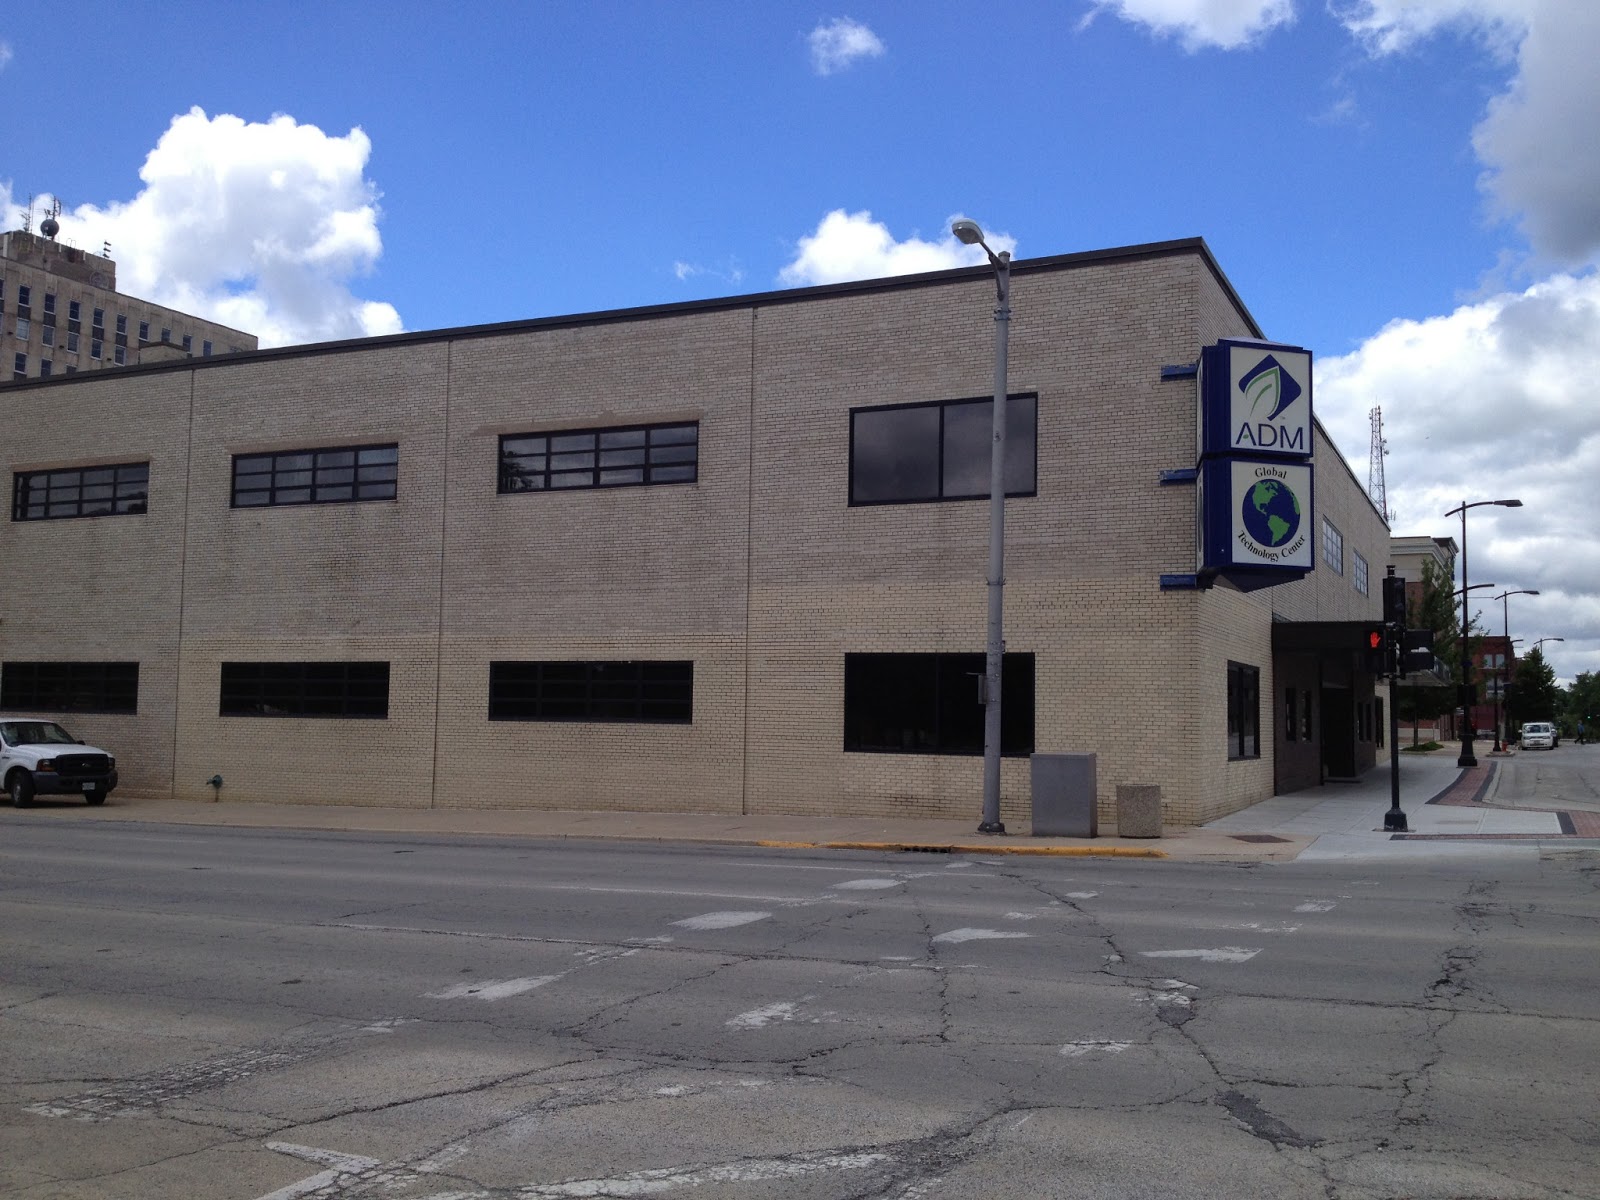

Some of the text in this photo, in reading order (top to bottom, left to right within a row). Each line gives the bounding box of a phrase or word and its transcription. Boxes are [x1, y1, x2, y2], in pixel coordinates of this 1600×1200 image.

[1235, 422, 1303, 450] ADM
[1254, 467, 1287, 479] Global
[1238, 530, 1305, 562] Technology Center
